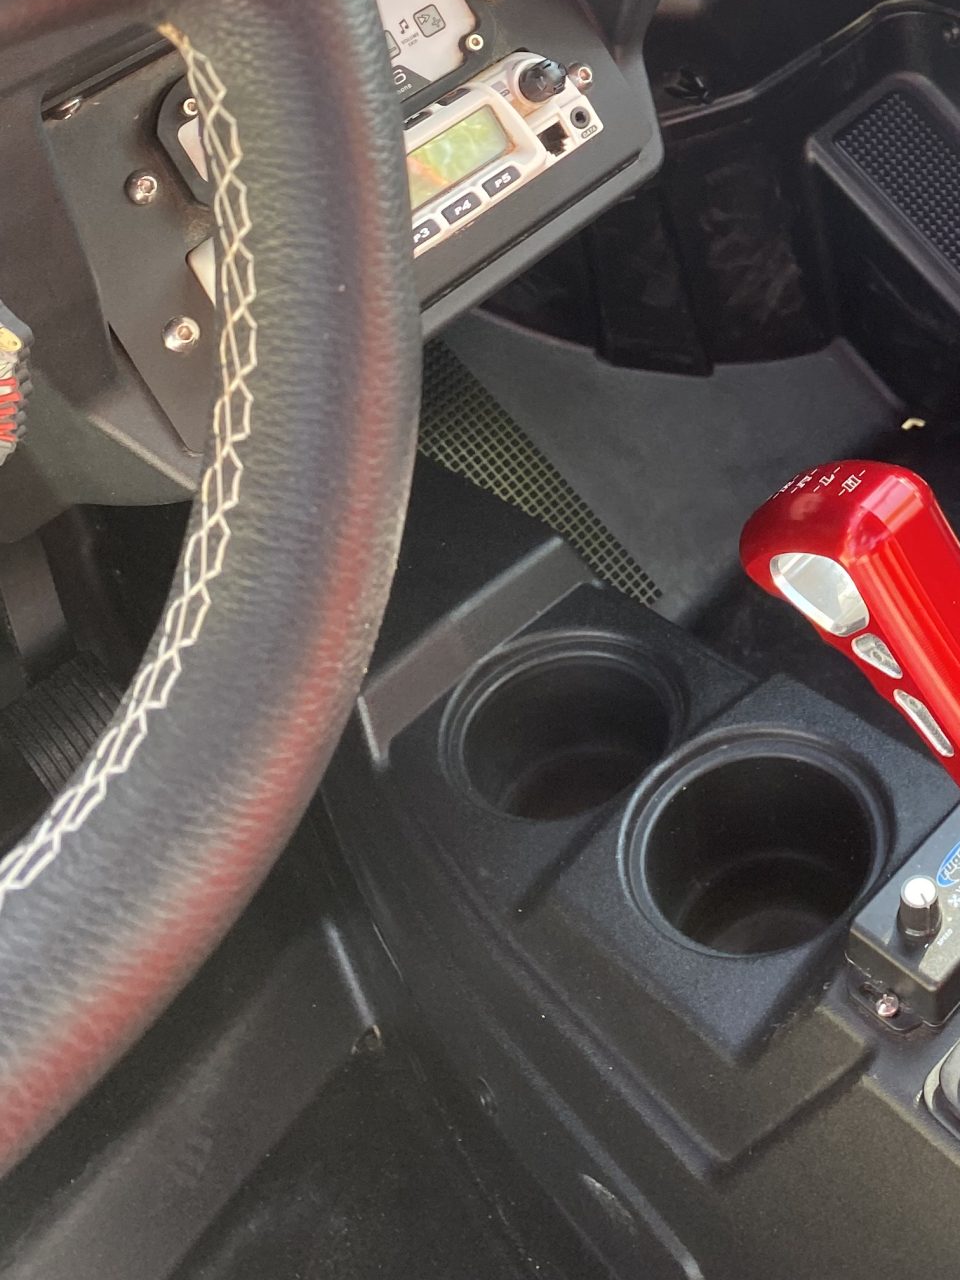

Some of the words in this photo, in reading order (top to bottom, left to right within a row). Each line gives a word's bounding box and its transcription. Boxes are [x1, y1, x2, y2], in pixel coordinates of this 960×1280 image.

[494, 172, 512, 189] P5
[454, 199, 472, 216] P4
[413, 227, 431, 243] P3
[841, 474, 862, 493] H
